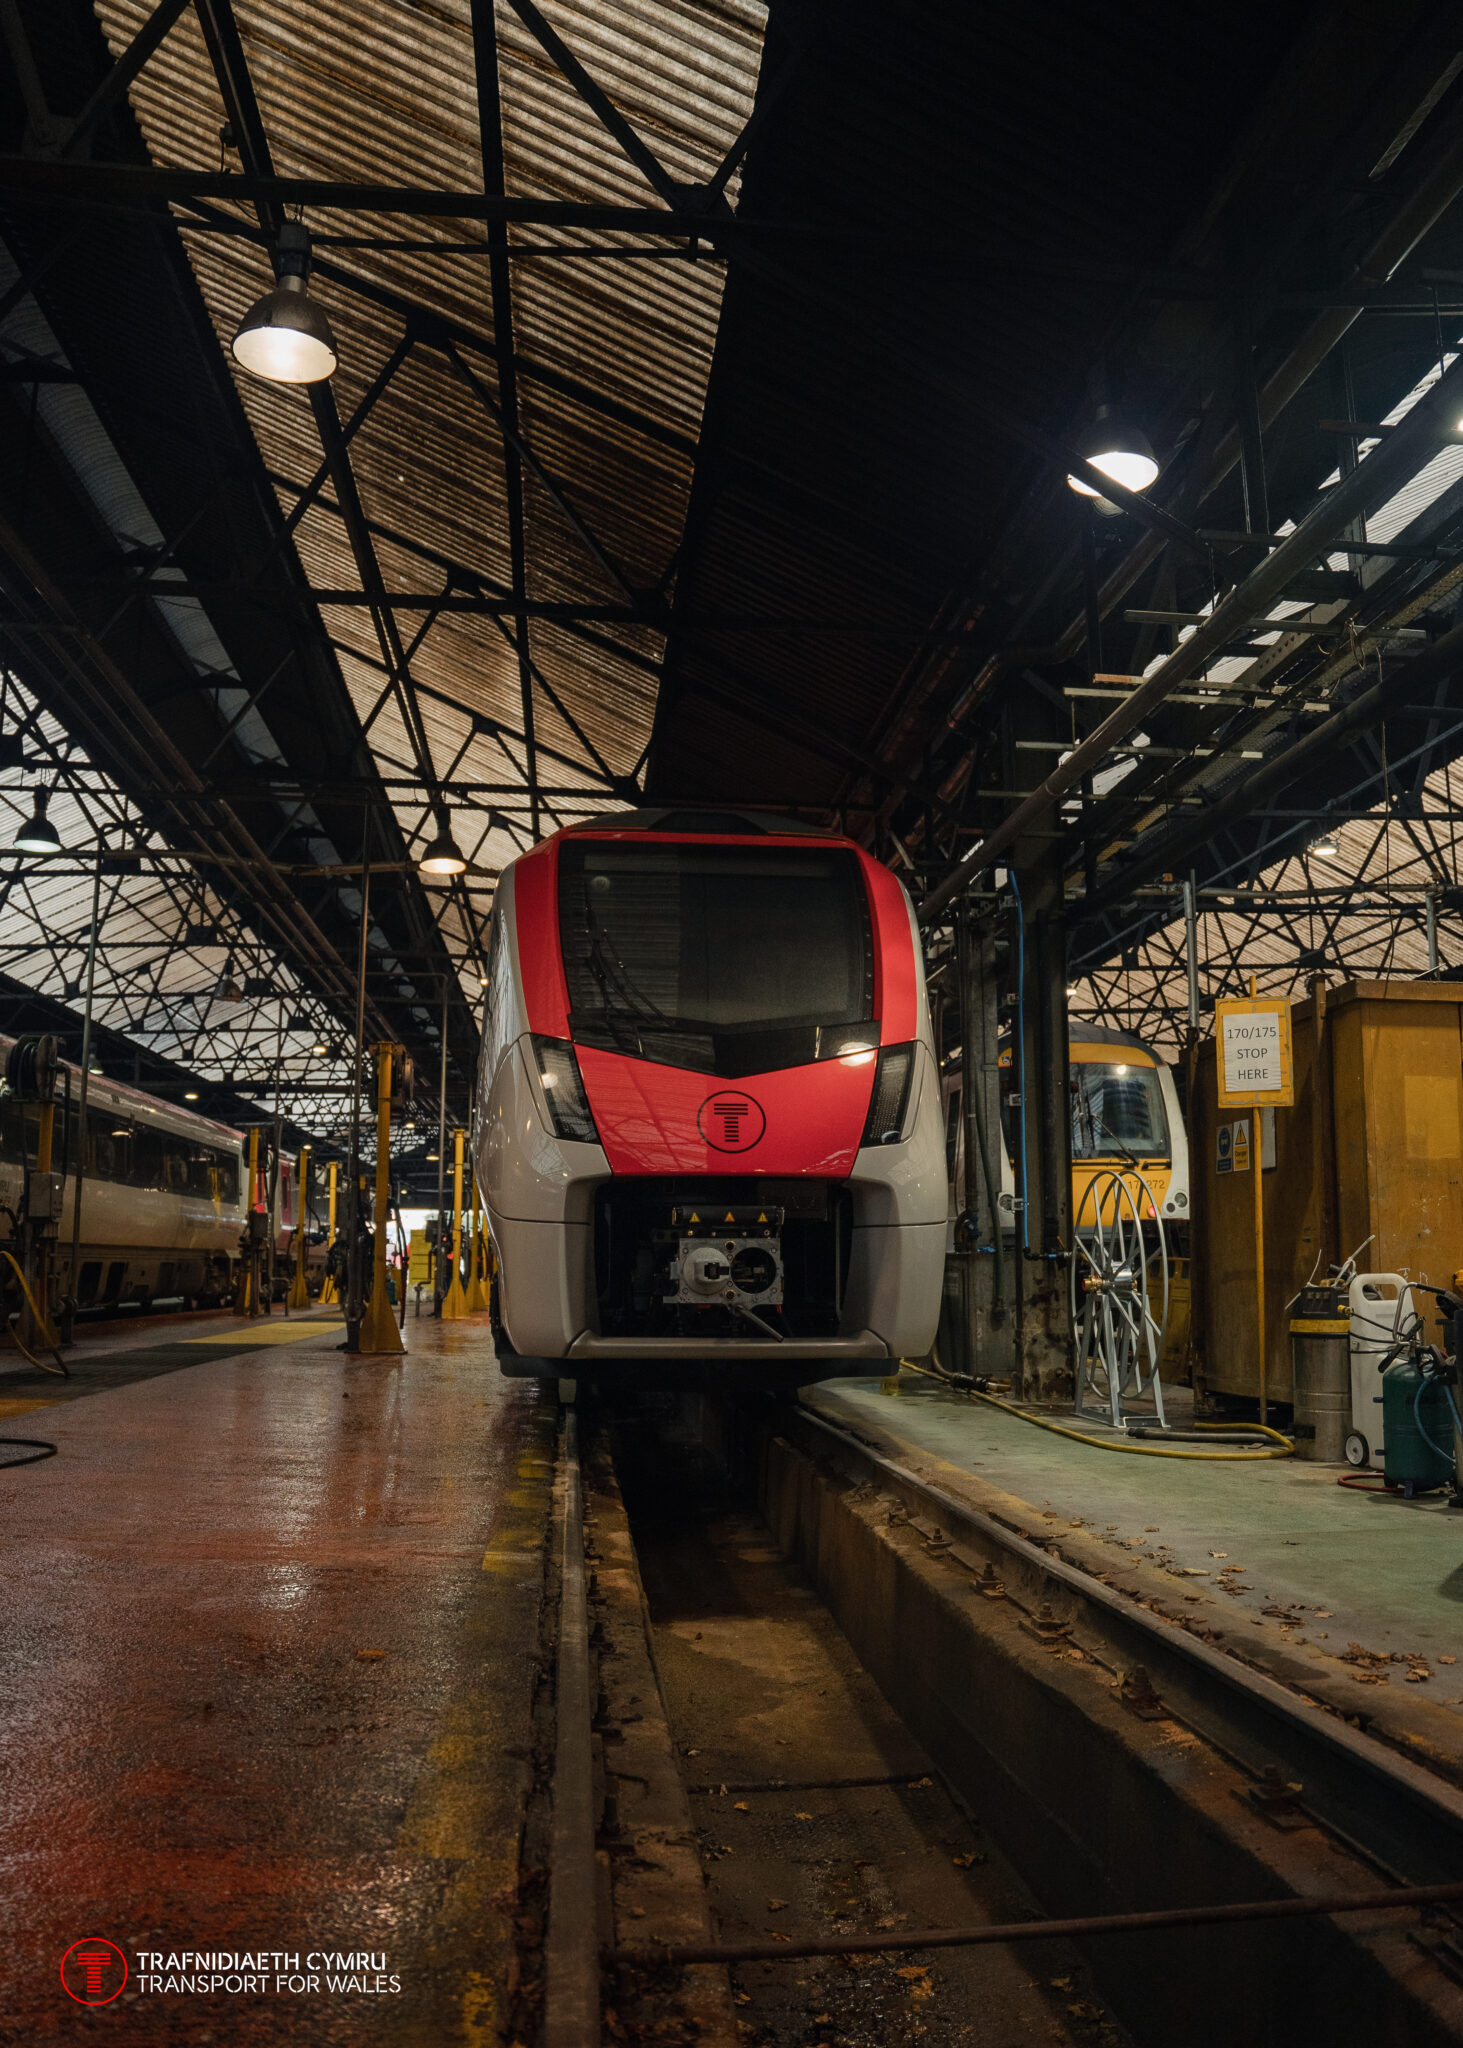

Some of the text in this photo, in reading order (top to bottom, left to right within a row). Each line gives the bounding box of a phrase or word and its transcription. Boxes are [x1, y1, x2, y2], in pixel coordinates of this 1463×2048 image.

[1227, 1026, 1277, 1040] 170/175
[1237, 1047, 1268, 1059] STOP
[1238, 1068, 1269, 1080] HERE
[1128, 1179, 1166, 1190] 17272
